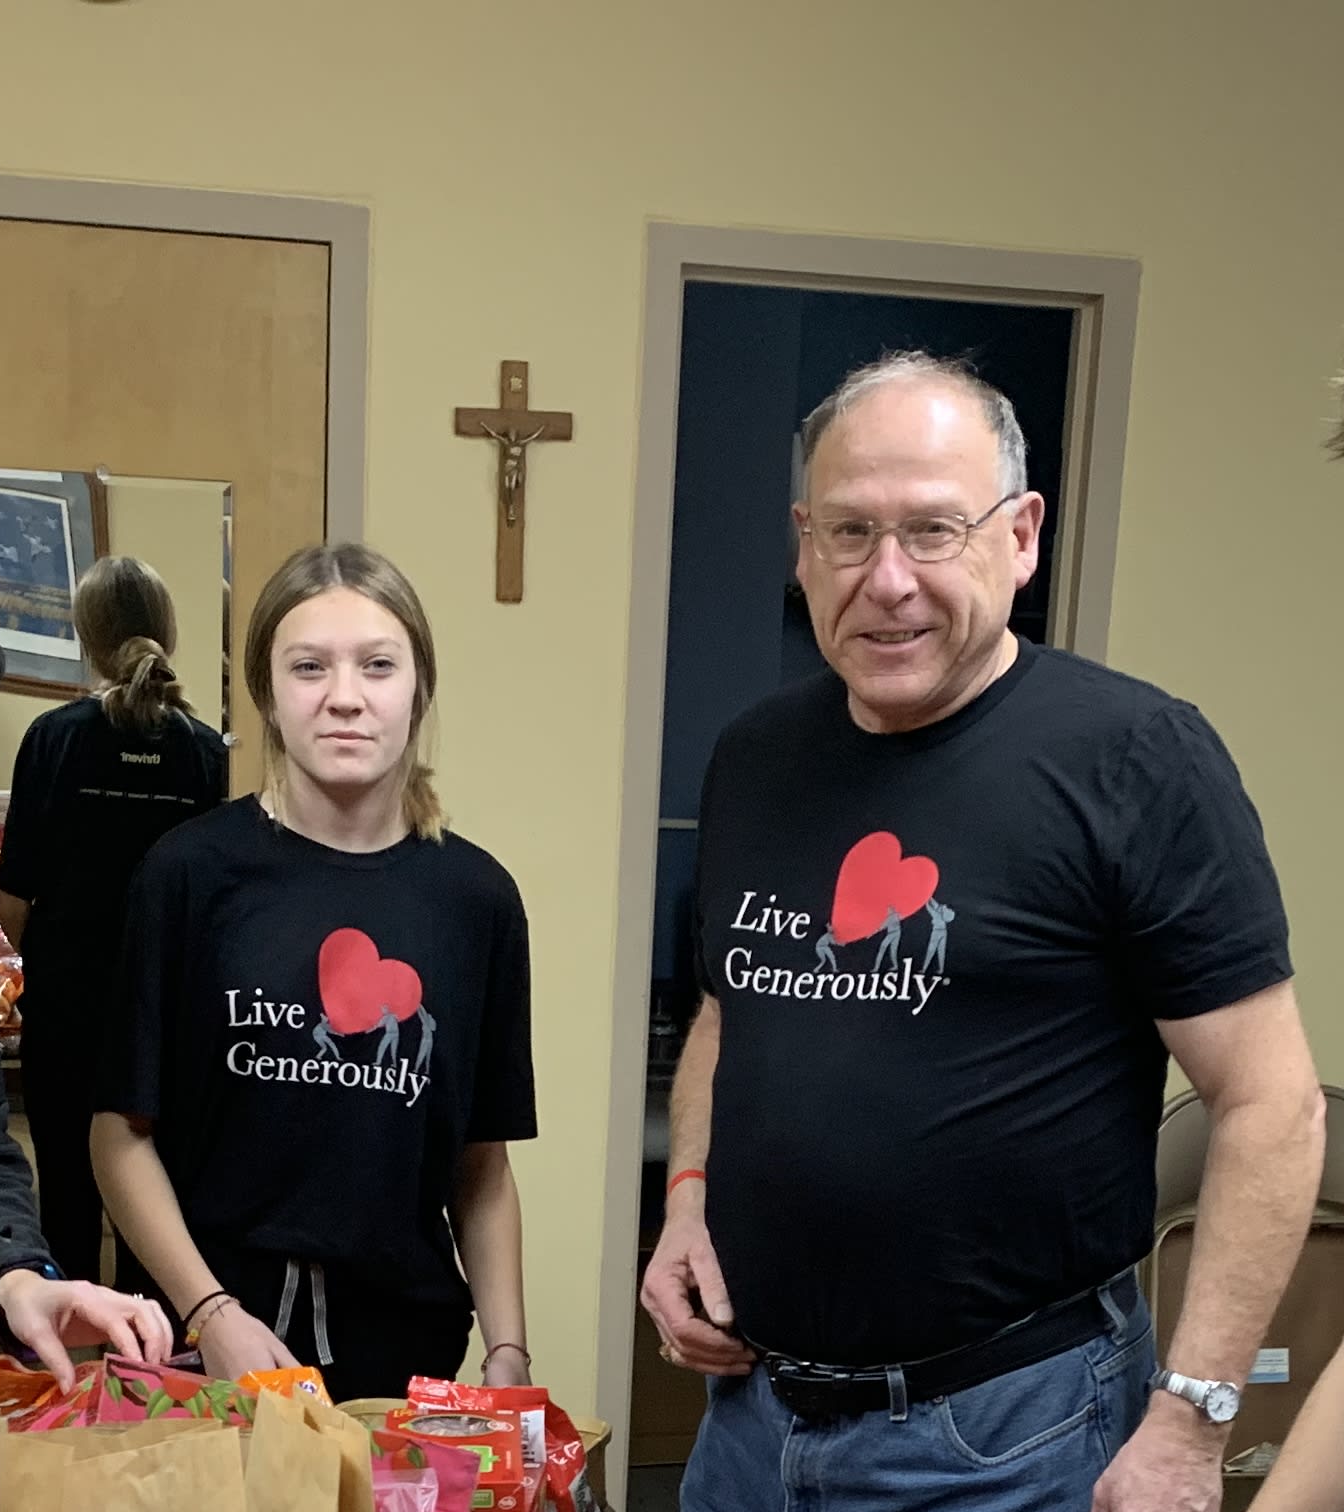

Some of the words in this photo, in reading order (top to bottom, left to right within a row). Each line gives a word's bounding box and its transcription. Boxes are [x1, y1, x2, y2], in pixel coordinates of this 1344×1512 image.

[730, 891, 811, 940] Live
[224, 987, 306, 1029] Live
[725, 947, 943, 1016] Generously
[227, 1040, 430, 1108] Generously
